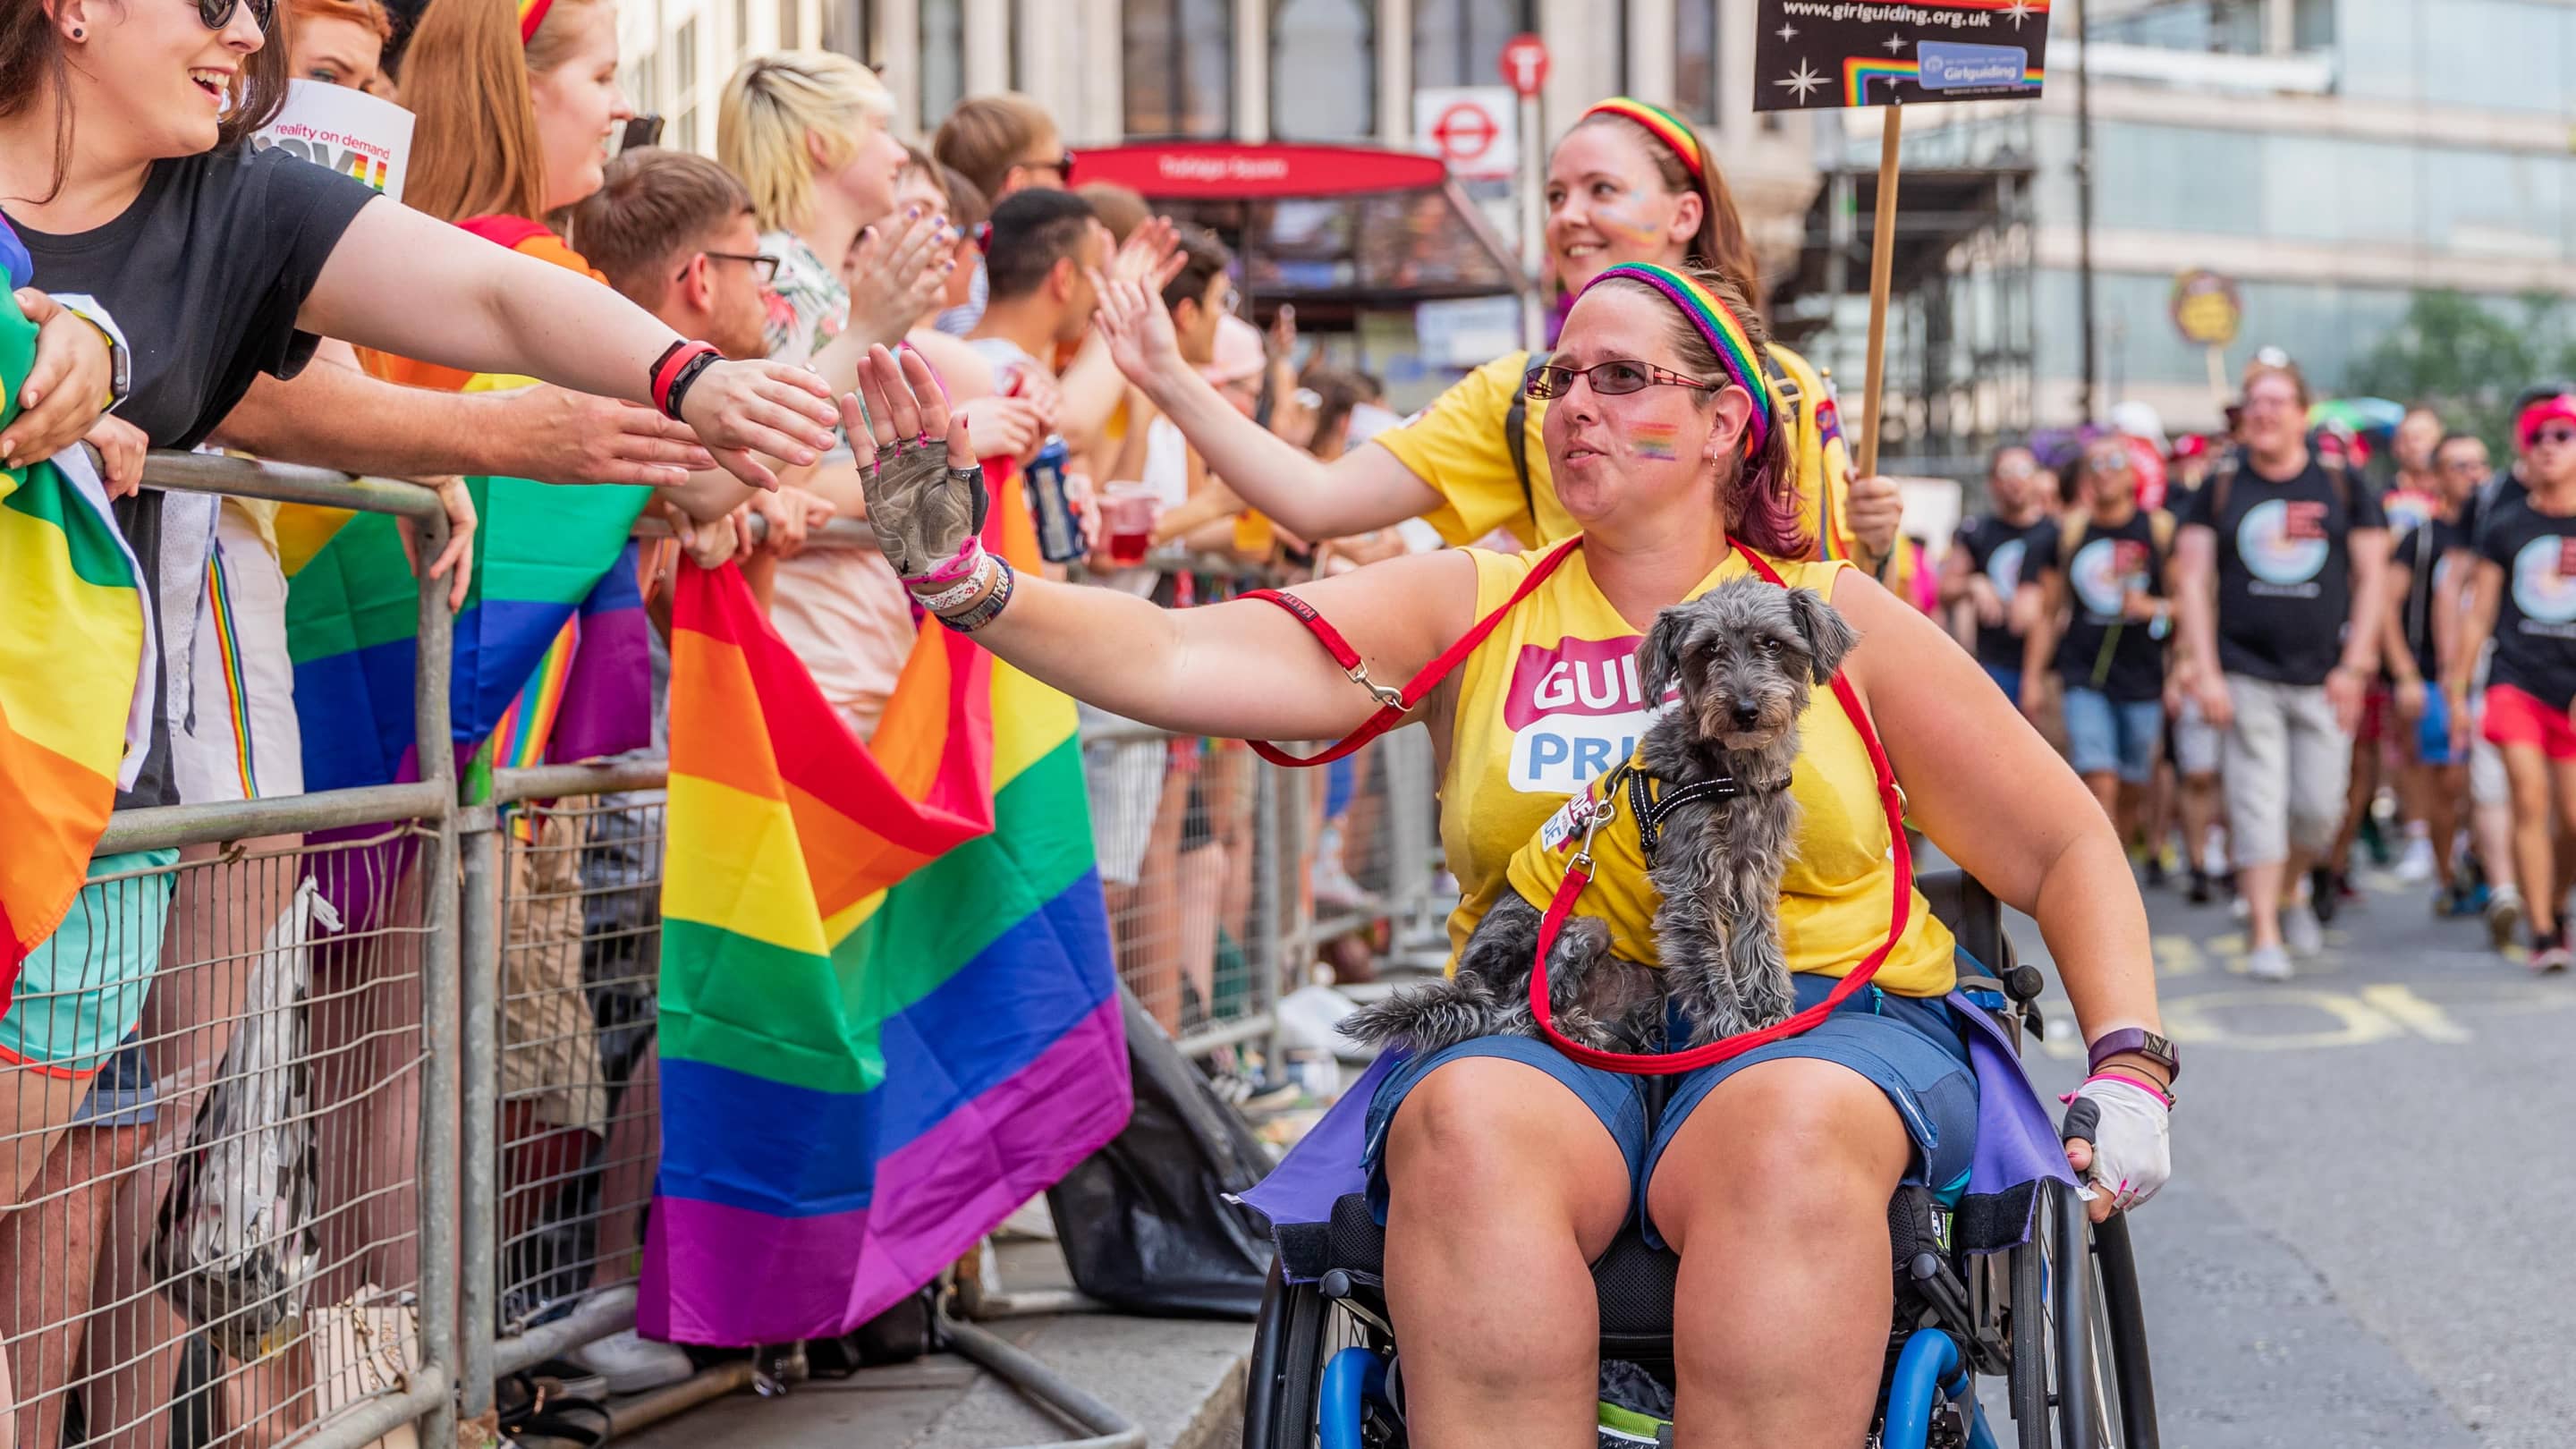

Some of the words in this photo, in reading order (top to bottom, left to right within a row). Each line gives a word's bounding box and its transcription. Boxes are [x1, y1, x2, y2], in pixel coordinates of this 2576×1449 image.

[1784, 2, 1991, 28] www.girlguiding.org.uk
[1944, 65, 2017, 82] Girlguiding
[275, 123, 317, 140] reality
[320, 130, 339, 143] on
[343, 135, 390, 159] demand
[1533, 654, 1641, 710] GUI
[1529, 733, 1634, 781] PRI
